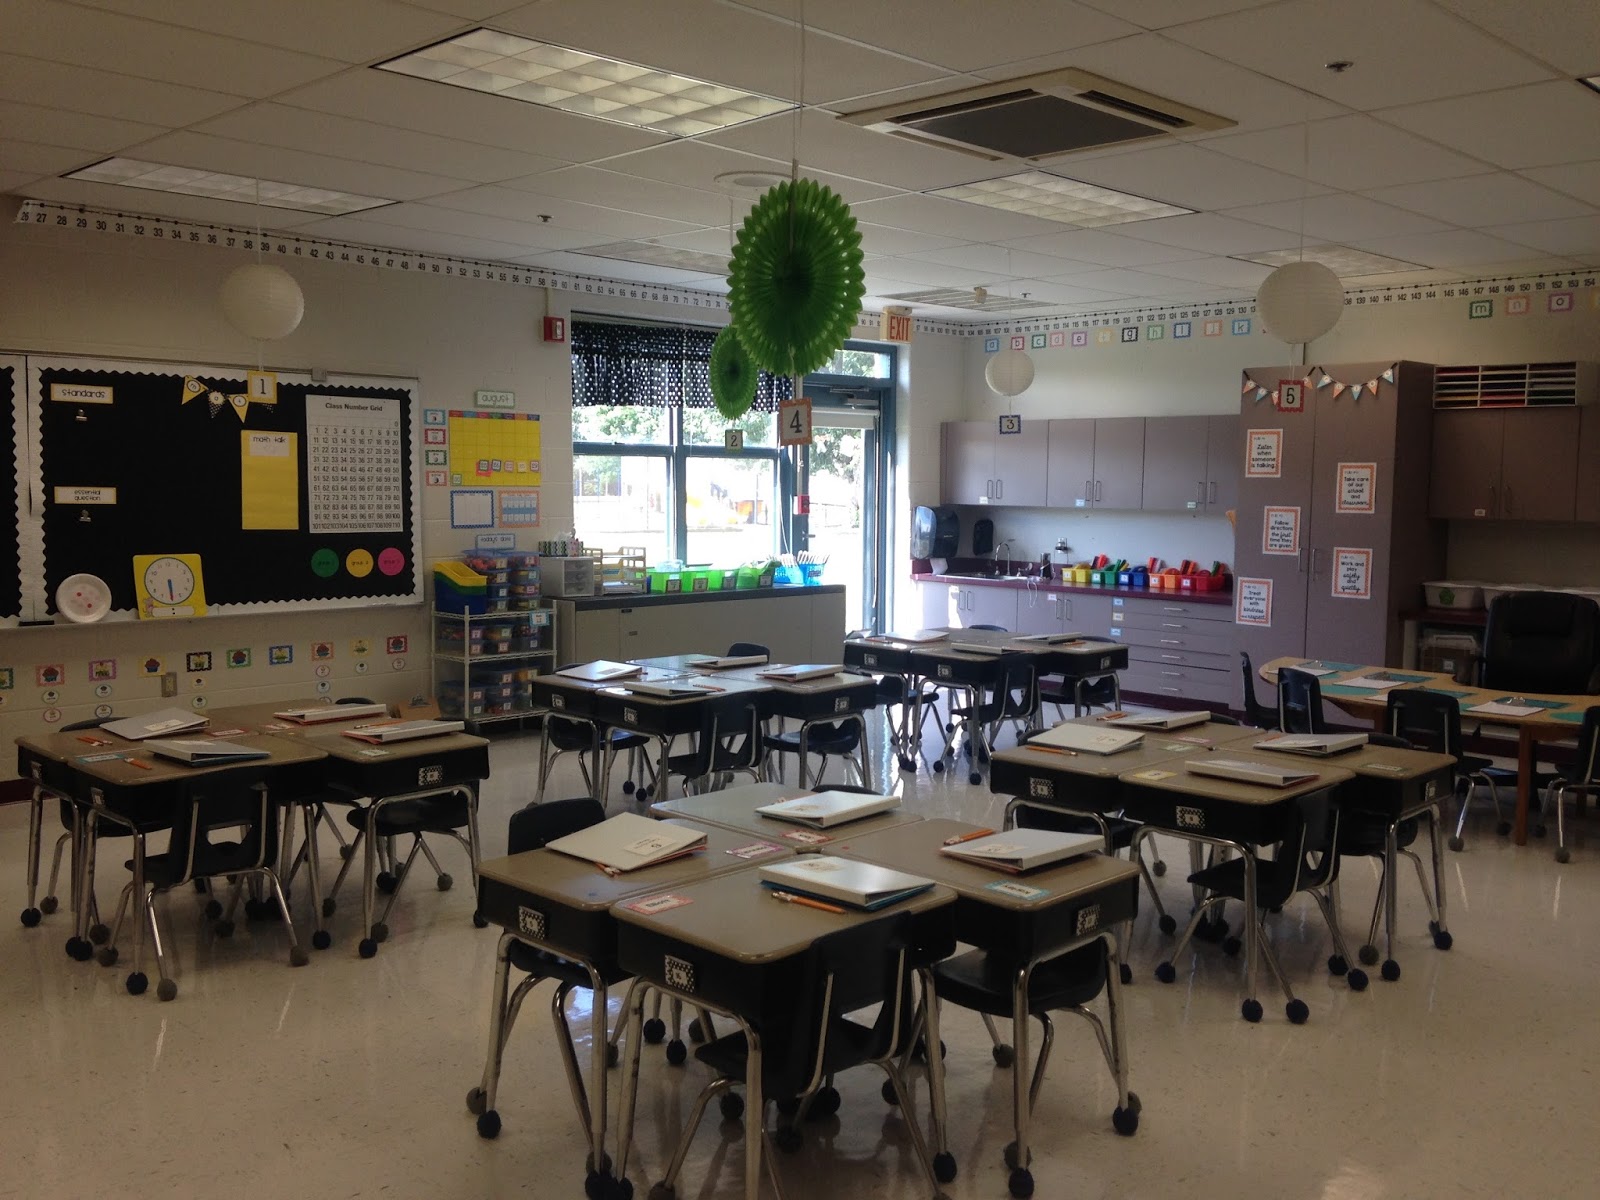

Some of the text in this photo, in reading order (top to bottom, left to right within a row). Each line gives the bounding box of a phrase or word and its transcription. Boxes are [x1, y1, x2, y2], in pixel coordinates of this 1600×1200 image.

[21, 212, 29, 221] 26
[37, 213, 46, 222] 27
[57, 216, 67, 225] 28
[77, 218, 86, 228] 29
[96, 221, 106, 230] 30
[116, 224, 124, 232] 31
[135, 226, 144, 234] 32
[154, 228, 163, 237] 33
[172, 230, 181, 239] 34
[190, 232, 199, 241] 35
[208, 235, 216, 244] 36
[226, 238, 235, 246] 37
[244, 240, 252, 249] 38
[261, 242, 269, 251] 39
[277, 245, 285, 253] 40
[294, 247, 301, 255] 41
[310, 249, 318, 257] 42
[326, 251, 334, 259] 43
[356, 255, 364, 264] 45
[371, 257, 379, 265] 46
[890, 316, 910, 340] EXIT
[1127, 330, 1132, 339] g
[1238, 323, 1244, 331] k
[62, 389, 105, 398] standards
[482, 395, 508, 404] august
[1287, 388, 1294, 404] 5
[790, 410, 802, 433] 4
[1007, 419, 1014, 429] 3
[731, 435, 737, 446] 2
